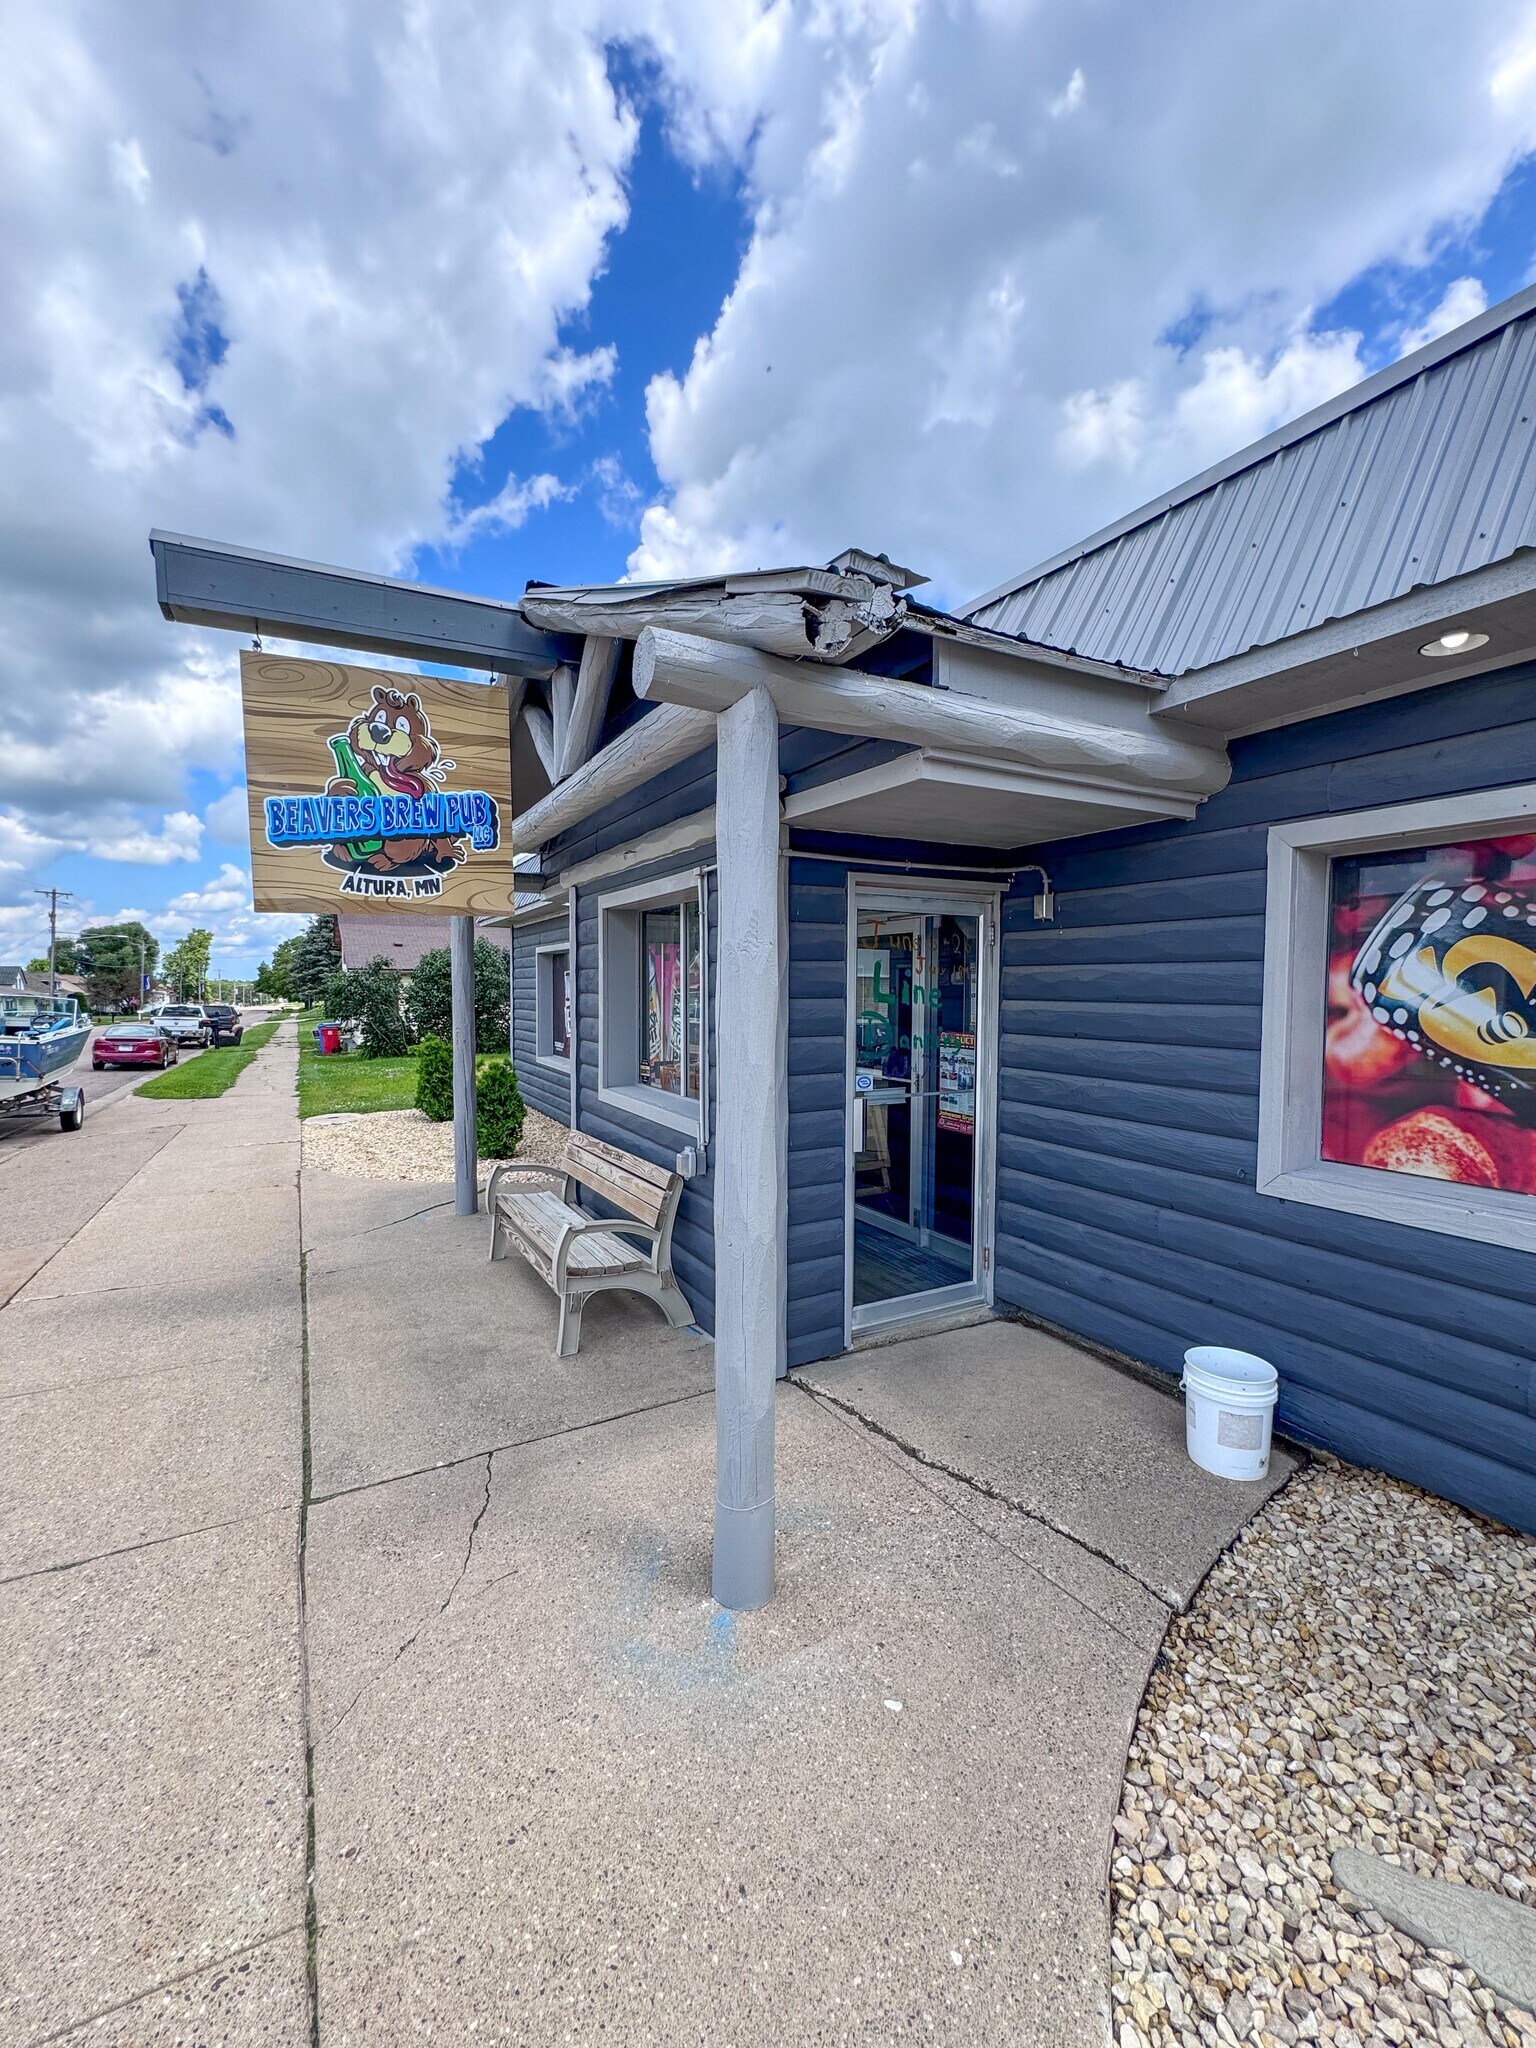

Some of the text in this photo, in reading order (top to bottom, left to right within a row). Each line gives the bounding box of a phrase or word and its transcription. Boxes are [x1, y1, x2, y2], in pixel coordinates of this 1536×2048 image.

[267, 791, 490, 837] BEAVERS BREW PUB
[472, 825, 493, 846] LLC
[342, 876, 440, 897] ALTURA, MN
[873, 960, 942, 1009] Line
